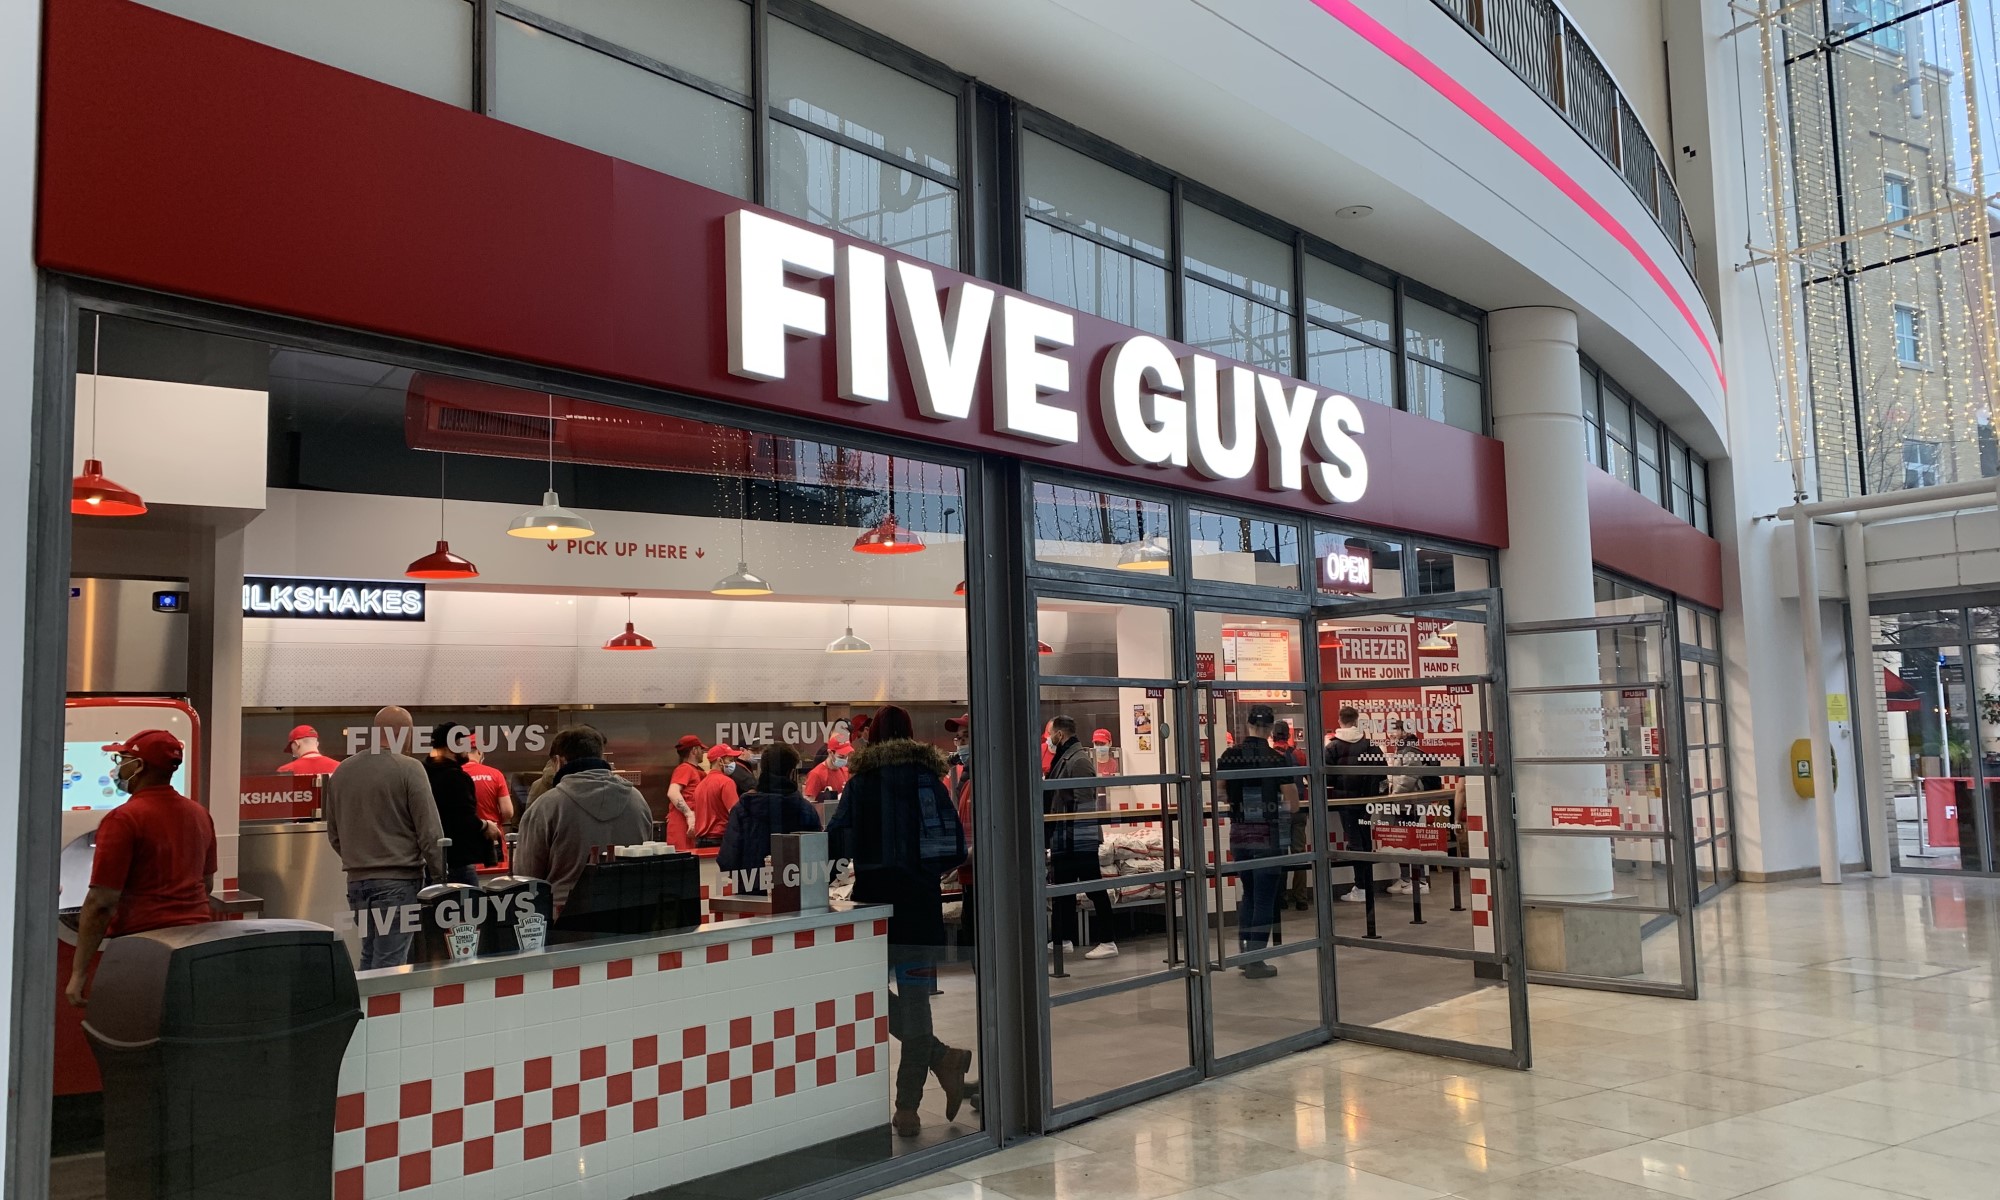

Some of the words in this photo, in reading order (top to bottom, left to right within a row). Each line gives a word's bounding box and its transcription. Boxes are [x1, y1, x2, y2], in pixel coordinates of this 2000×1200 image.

[725, 209, 1078, 443] FIVE
[1101, 335, 1368, 503] GUYS
[567, 539, 608, 556] PICK
[615, 542, 637, 557] UP
[645, 543, 687, 559] HERE
[1327, 553, 1369, 585] OPEN
[1400, 624, 1407, 632] A
[1342, 638, 1407, 660] FREEZER
[1340, 667, 1351, 678] IN
[1355, 667, 1376, 678] THE
[1380, 667, 1410, 678] JOINT
[1424, 662, 1448, 672] HAND
[1148, 688, 1162, 697] PULL
[1339, 699, 1385, 709] FRESHER
[1387, 699, 1415, 709] THAN
[1358, 717, 1398, 734] FIVE
[1402, 717, 1454, 733] GUYS
[346, 726, 433, 755] FIVE
[447, 724, 546, 753] GUYS
[716, 722, 774, 746] FIVE
[782, 721, 851, 744] GUYS
[1406, 738, 1419, 746] and
[1365, 803, 1400, 815] OPEN
[1404, 804, 1412, 815] 7
[1416, 804, 1451, 817] DAYS
[1432, 822, 1462, 830] 10:00pm
[783, 858, 850, 887] GUYS
[333, 903, 422, 941] FIVE
[434, 891, 536, 929] GUYS
[525, 917, 541, 925] HEINZ
[456, 926, 473, 934] HEINZ
